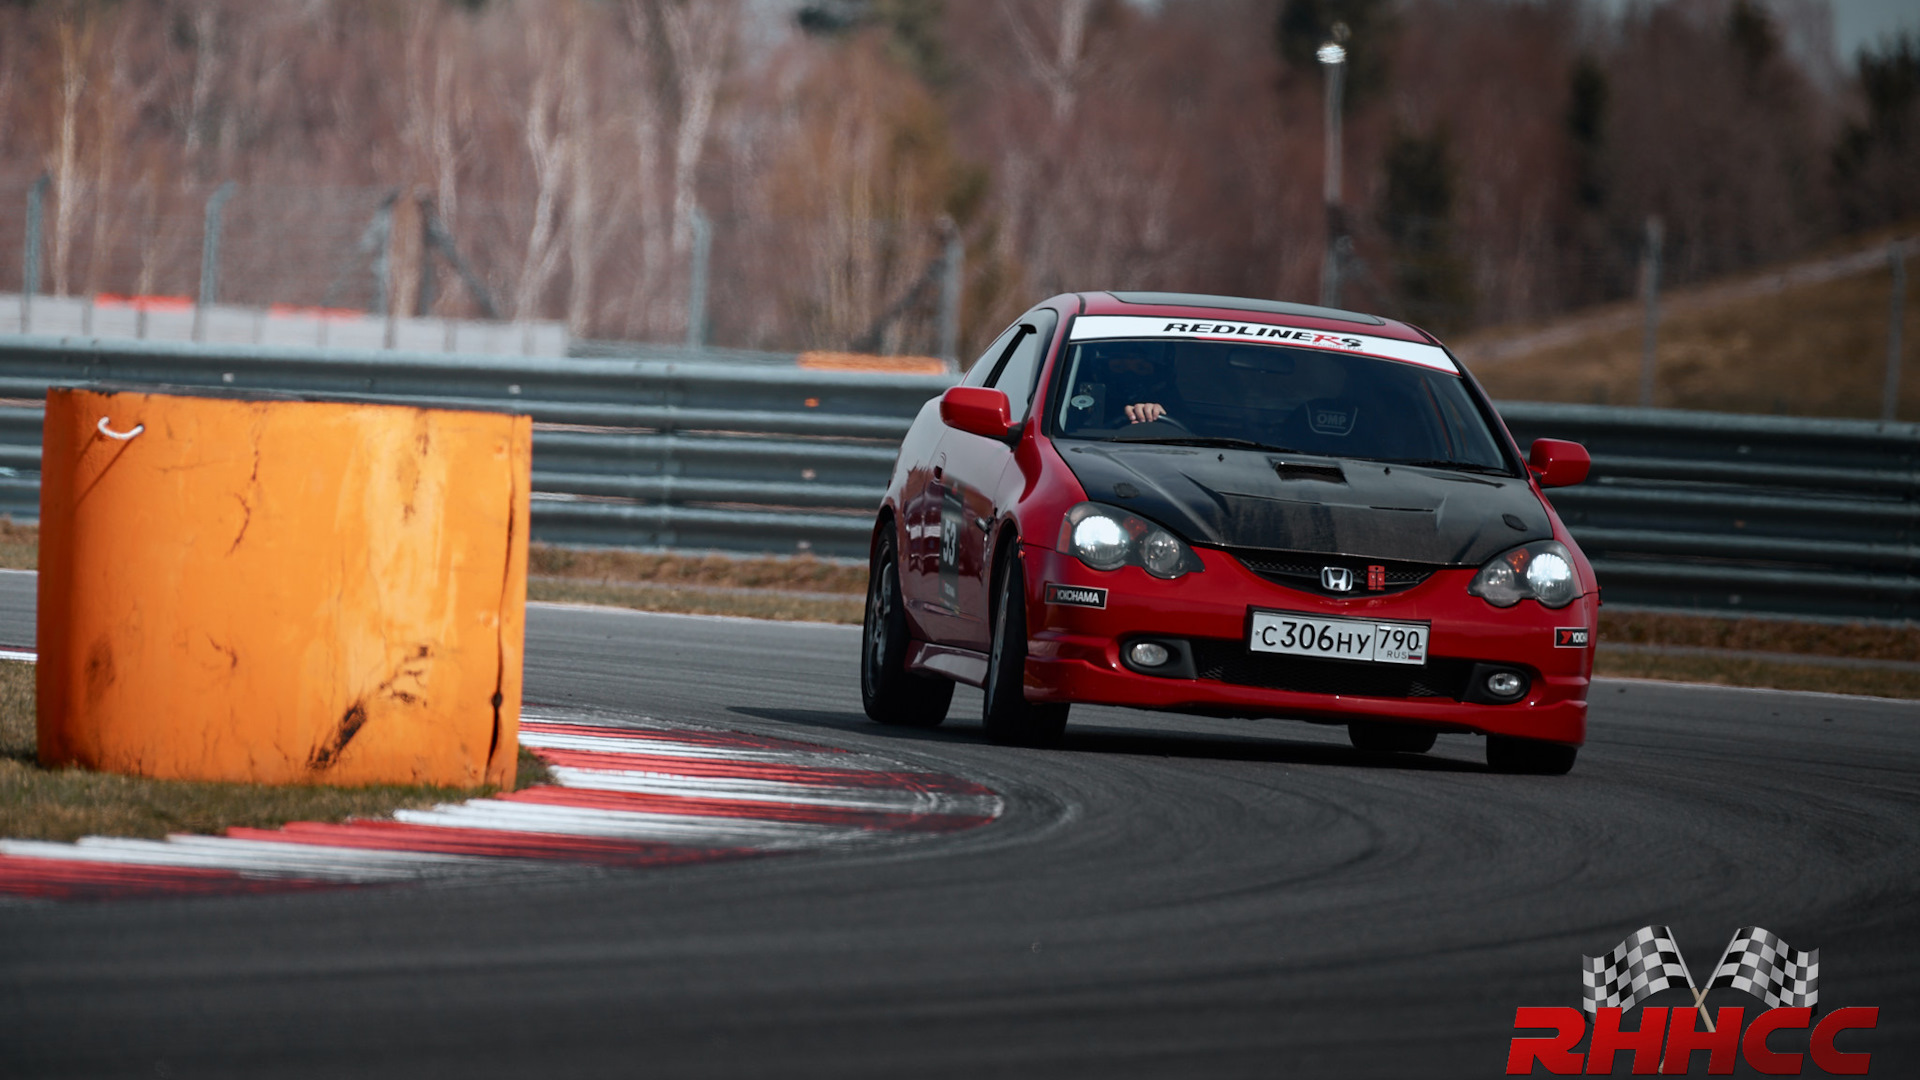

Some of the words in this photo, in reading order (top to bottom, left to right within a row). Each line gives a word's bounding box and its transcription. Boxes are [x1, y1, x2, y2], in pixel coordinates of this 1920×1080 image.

[1163, 322, 1363, 347] REDLINERS
[1316, 413, 1347, 426] OMP
[943, 519, 957, 566] 53
[1056, 588, 1100, 604] YOKOHAMA
[1379, 626, 1419, 651] 790
[1387, 650, 1407, 660] RUS
